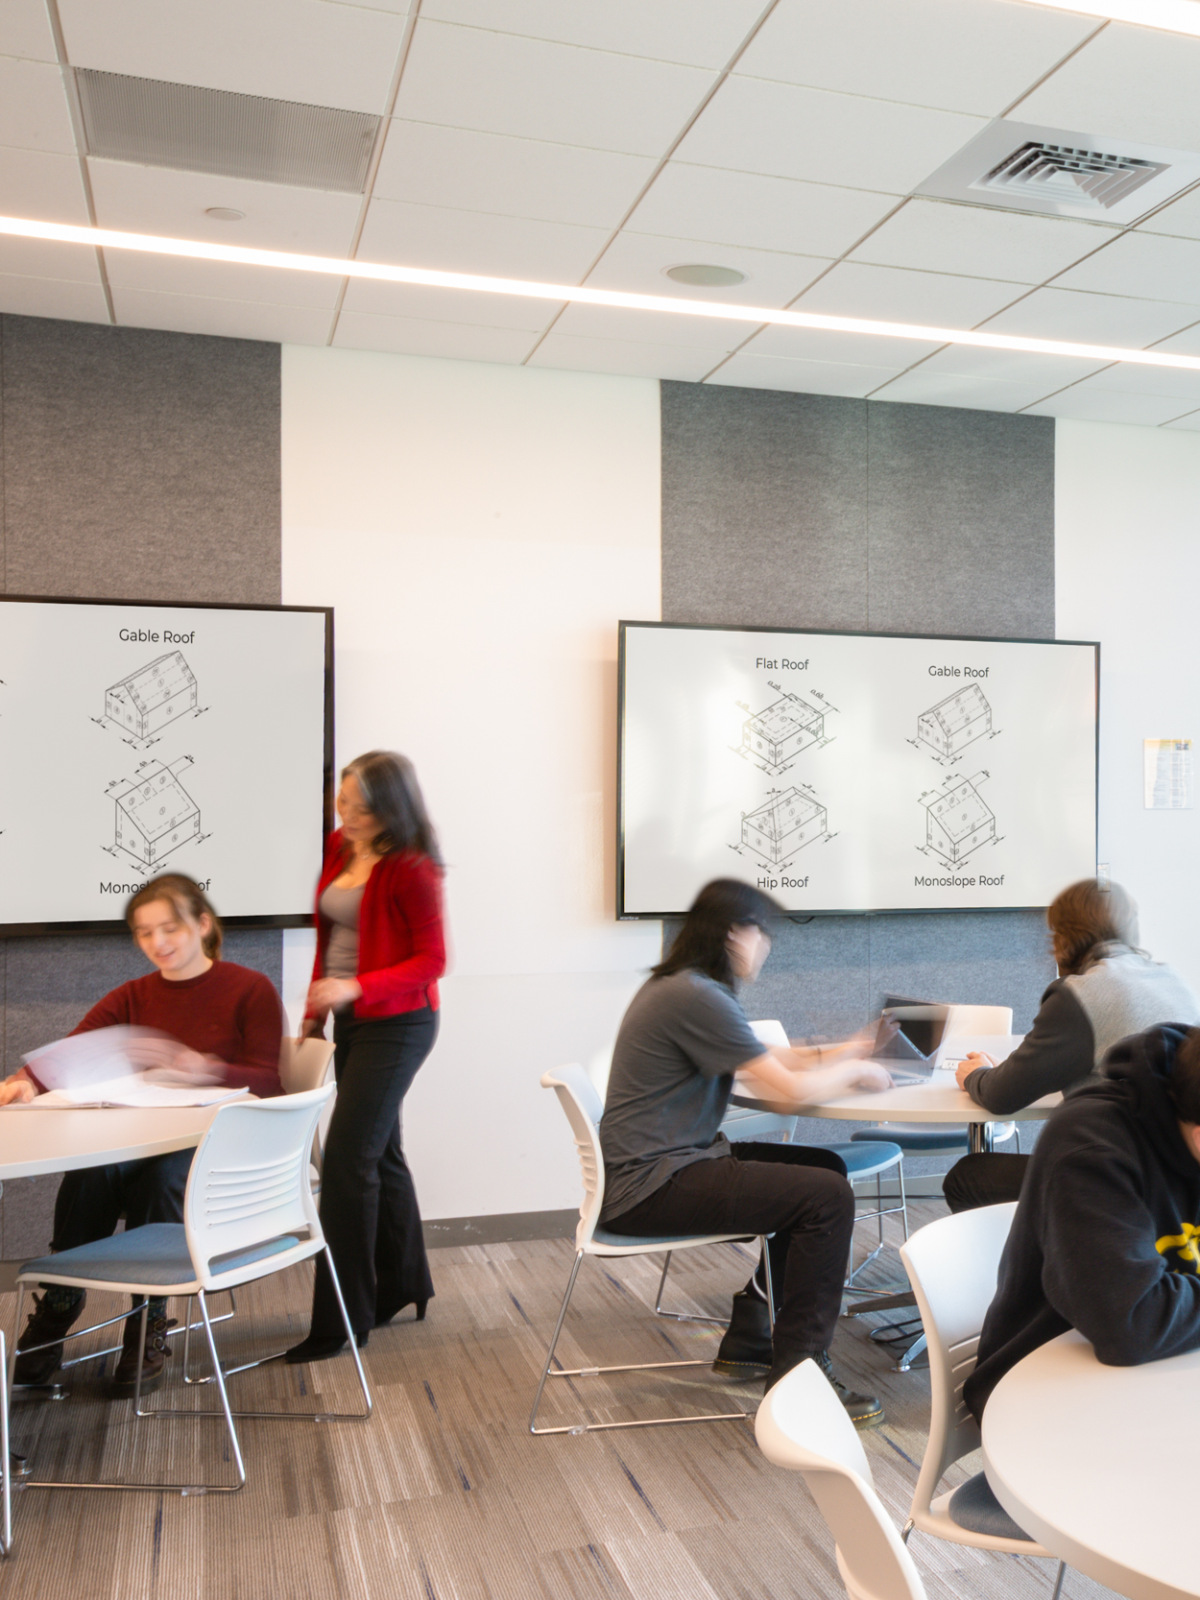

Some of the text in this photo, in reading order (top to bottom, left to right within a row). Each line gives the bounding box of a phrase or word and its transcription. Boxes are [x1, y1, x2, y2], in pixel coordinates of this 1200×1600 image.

[119, 628, 195, 644] Gable Roof
[755, 657, 809, 670] Flat Roof
[928, 665, 989, 678] Gable Roof
[757, 876, 809, 890] Hip Roof
[914, 874, 1005, 889] Monoslope Roof
